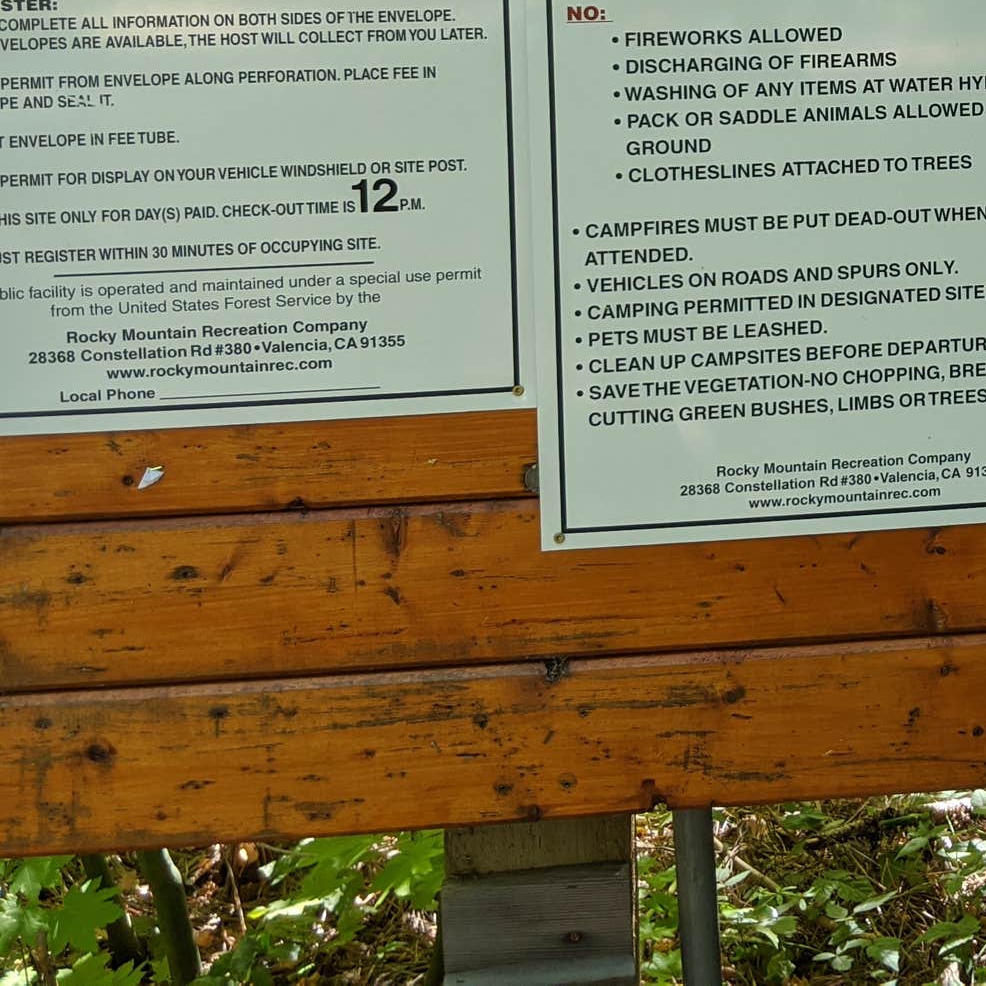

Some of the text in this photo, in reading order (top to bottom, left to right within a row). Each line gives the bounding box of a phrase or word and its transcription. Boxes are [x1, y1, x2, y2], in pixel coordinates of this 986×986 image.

[567, 6, 607, 20] NO:
[625, 27, 842, 47] FIREWORKS ALLOWED
[626, 52, 896, 74] DISCHARGING OF FIREARMS
[587, 260, 958, 292] VEHICLES ON ROADS AND SPURS ONLY.
[67, 321, 368, 345] Rocky Mountain Recreation Company
[589, 320, 827, 347] PETS MUST BE LEASHED.
[106, 360, 332, 379] www.rockymountainrec.com
[60, 389, 155, 403] Local Phone
[749, 488, 940, 508] www.rockymountainrec.com
